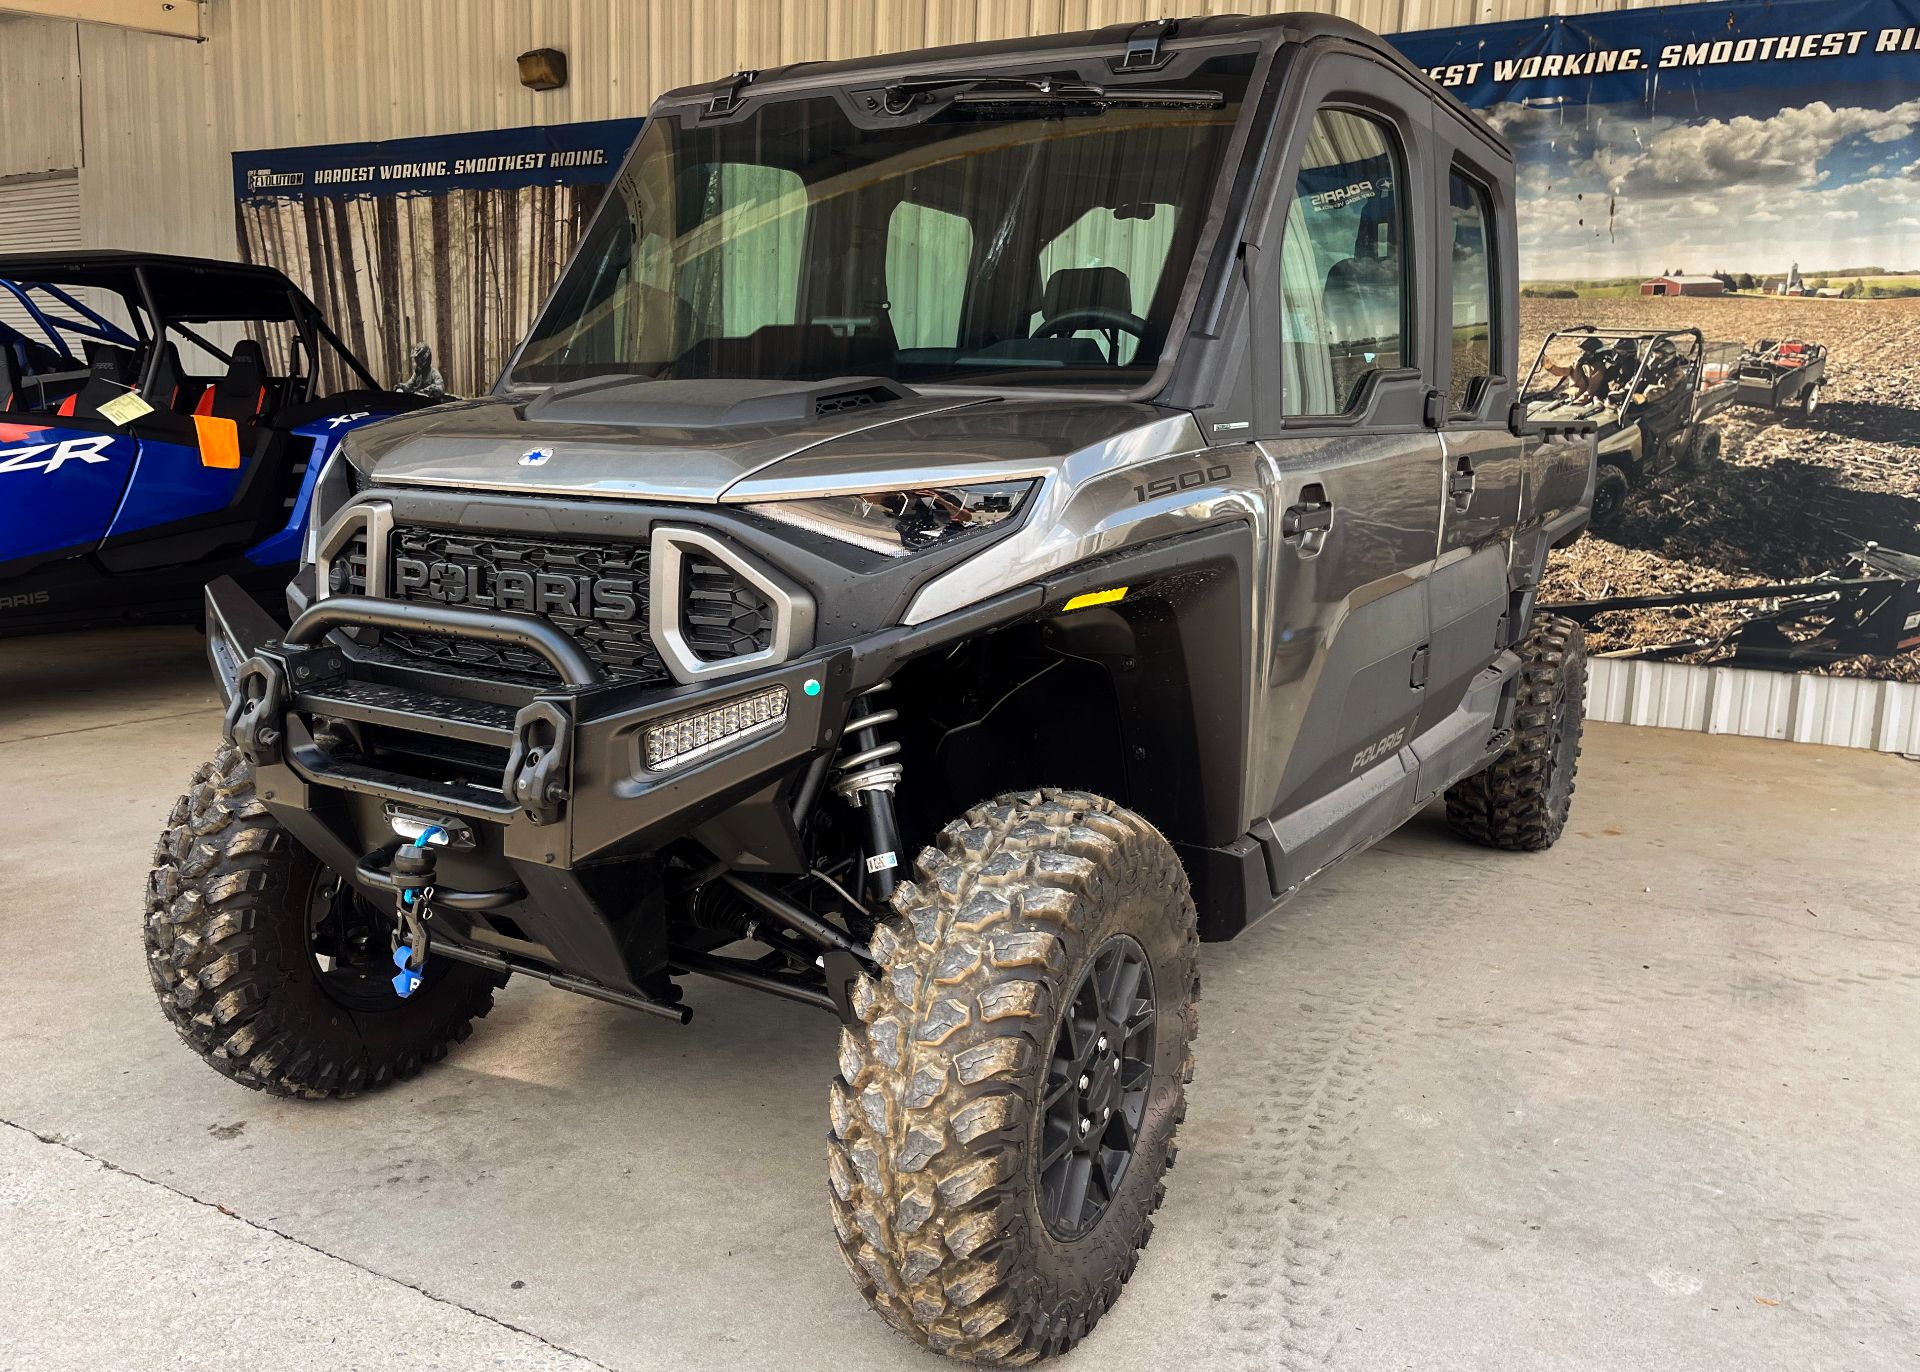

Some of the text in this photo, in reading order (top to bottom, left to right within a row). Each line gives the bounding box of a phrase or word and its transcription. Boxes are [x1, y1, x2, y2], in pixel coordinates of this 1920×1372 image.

[1419, 62, 1484, 87] EST
[1493, 48, 1649, 82] WORKING.
[1658, 30, 1868, 68] SMOOTHEST
[314, 149, 609, 185] HARDEST WORKING. SMOOTHEST RIDING.
[327, 411, 370, 430] XP
[1133, 464, 1232, 503] 1500
[396, 557, 637, 621] POLARIS
[1350, 726, 1406, 773] POLARIS
